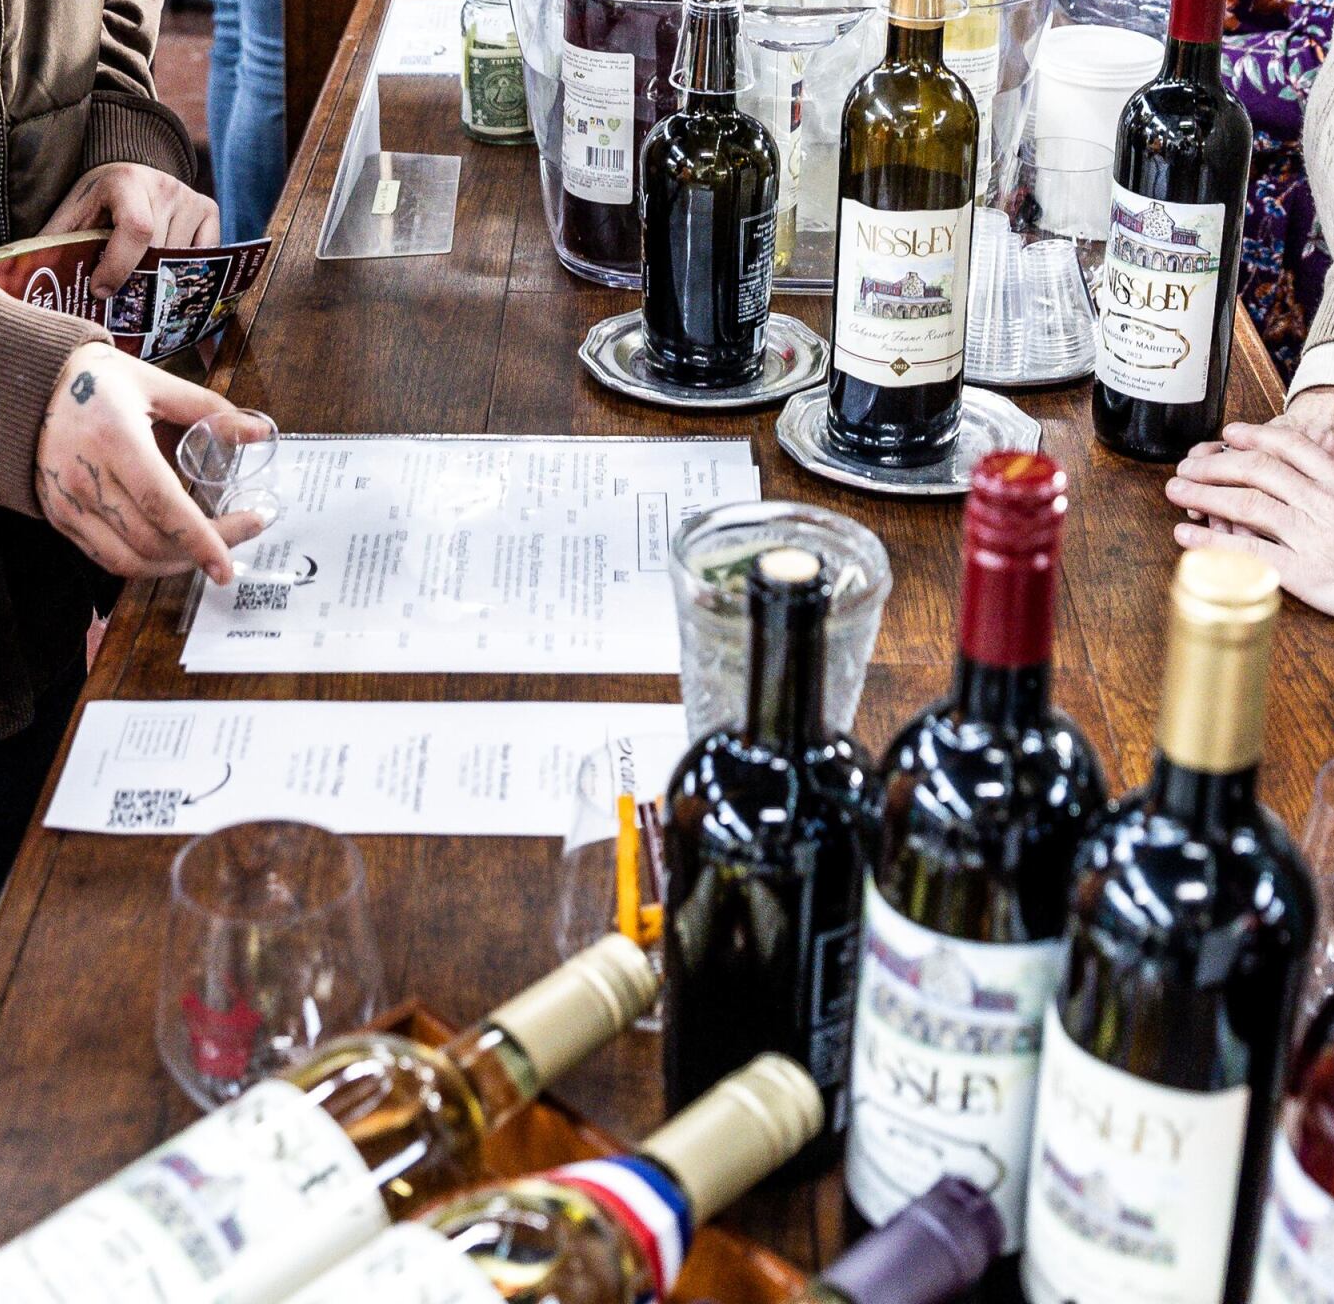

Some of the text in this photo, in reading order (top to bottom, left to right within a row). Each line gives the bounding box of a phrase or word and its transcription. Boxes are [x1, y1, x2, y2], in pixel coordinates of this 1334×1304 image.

[856, 221, 957, 258] NISSLEY
[1107, 264, 1197, 312] NISSLEY
[849, 322, 956, 343] Cabernet Franc Reserve
[1136, 341, 1182, 354] MARIETTA
